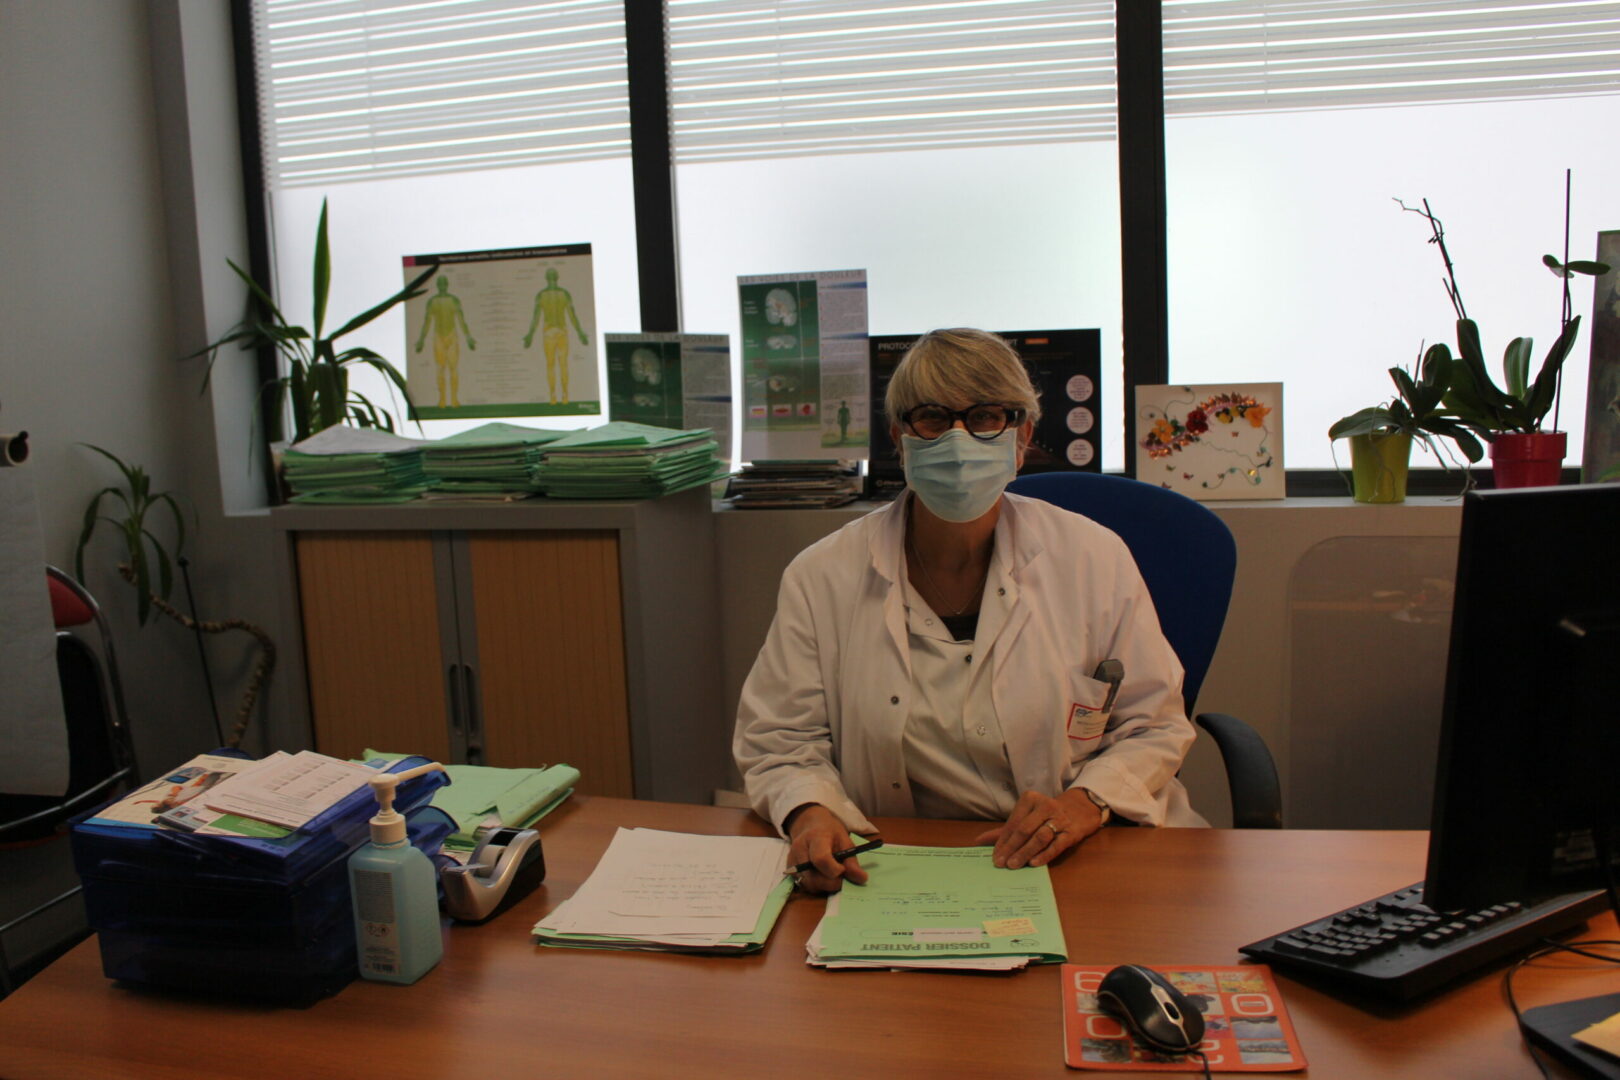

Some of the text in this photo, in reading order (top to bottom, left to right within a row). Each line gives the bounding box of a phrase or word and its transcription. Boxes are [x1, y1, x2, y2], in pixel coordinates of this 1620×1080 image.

[819, 270, 862, 279] DOULEUR
[861, 942, 991, 951] DOSSIER PATIENT
